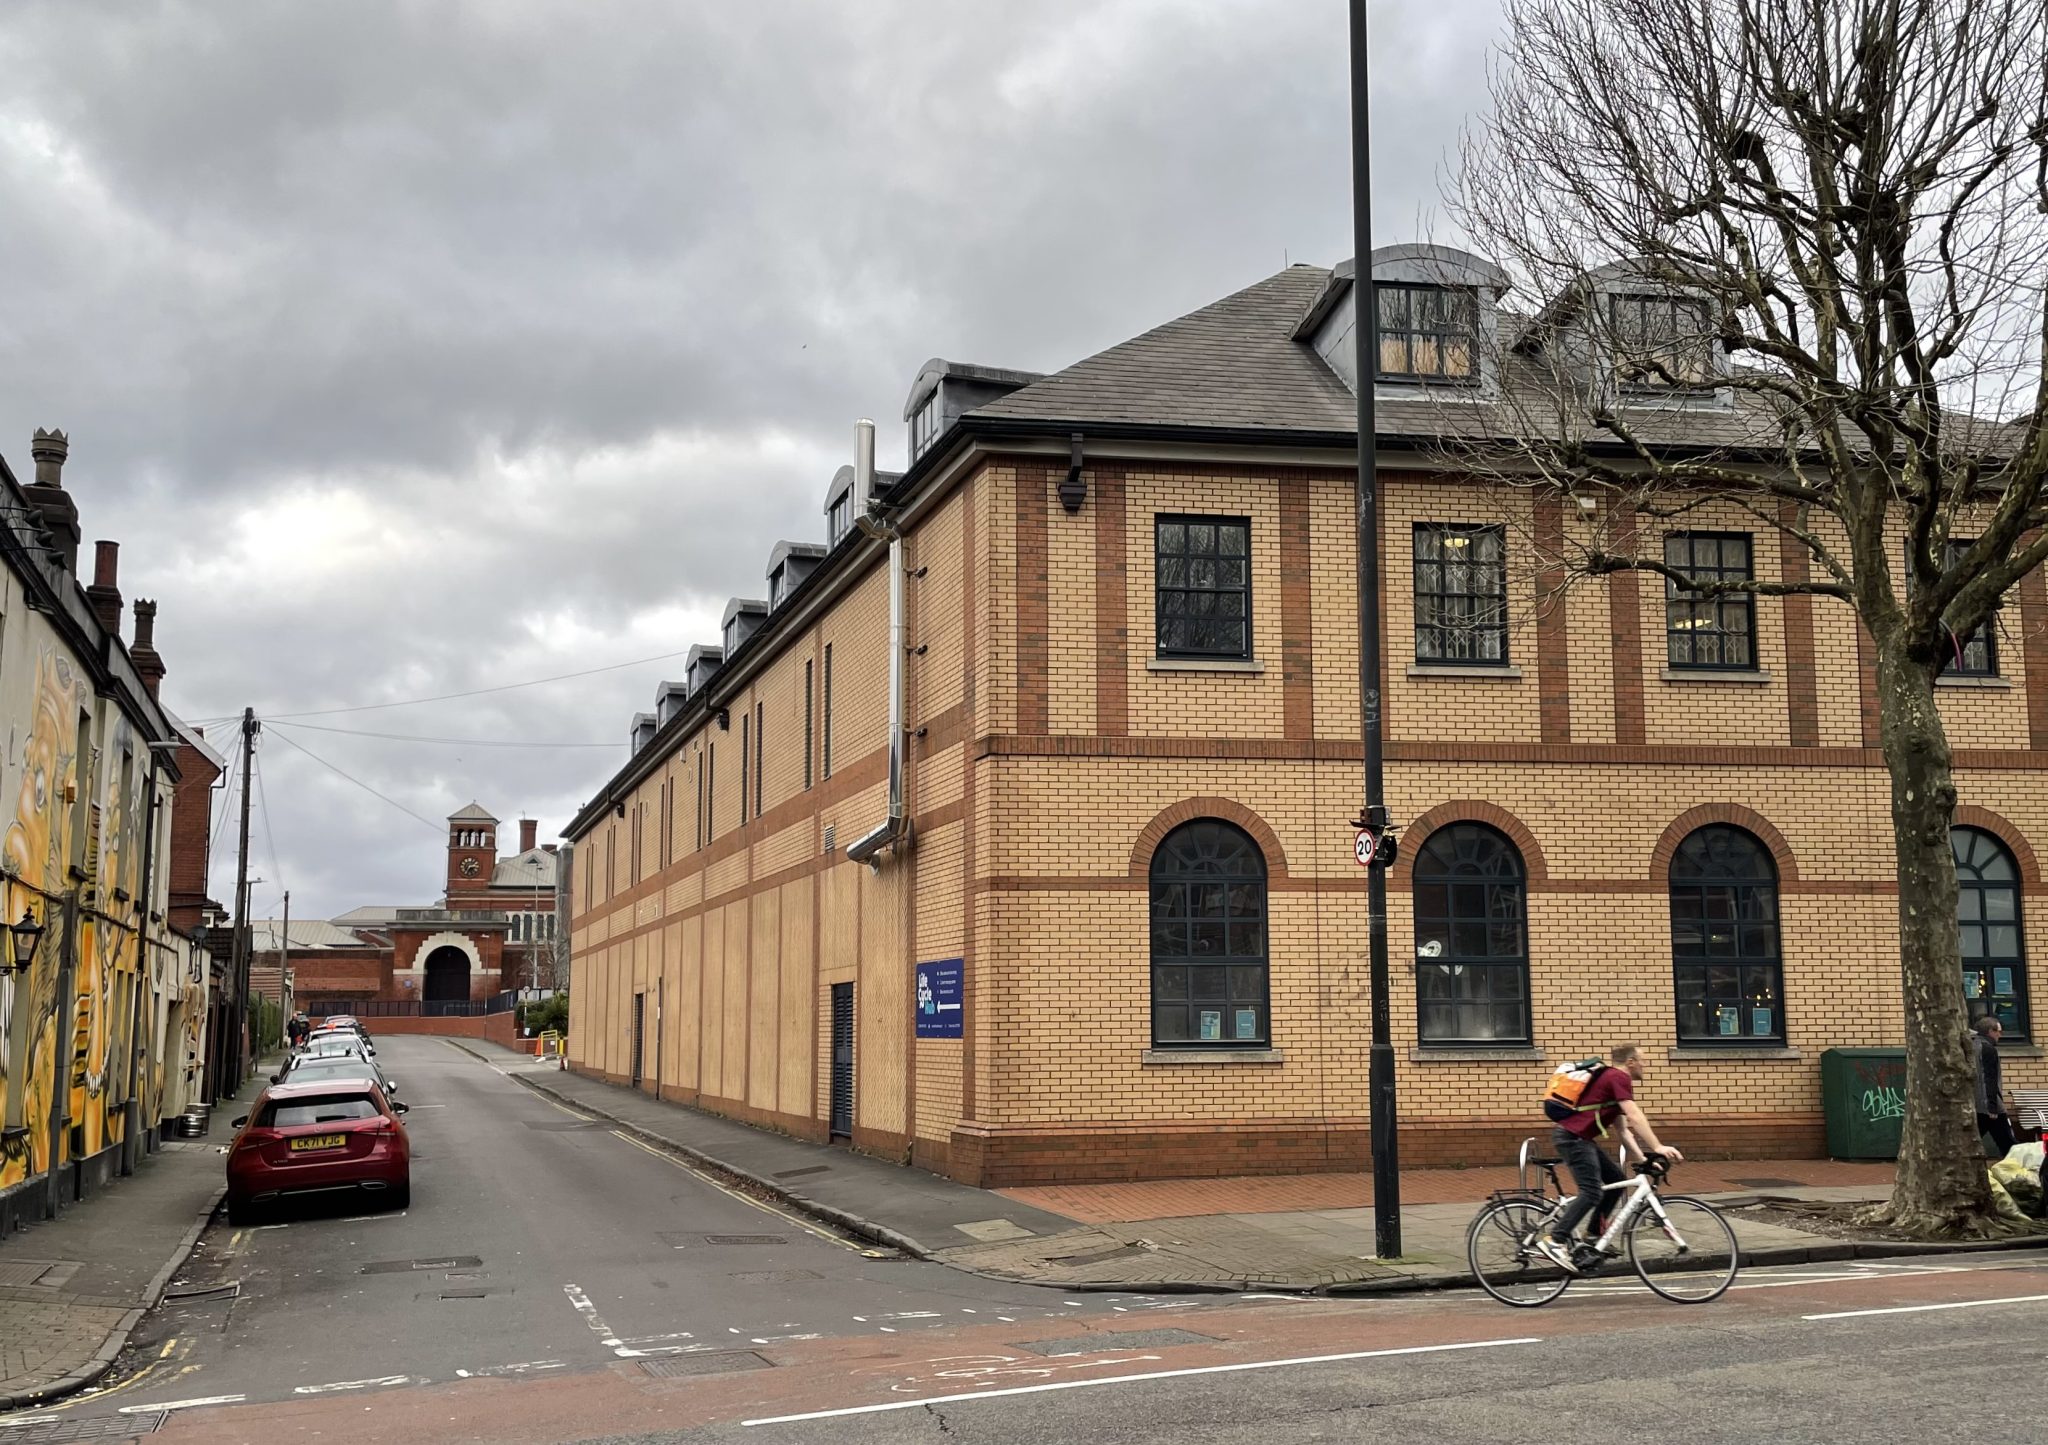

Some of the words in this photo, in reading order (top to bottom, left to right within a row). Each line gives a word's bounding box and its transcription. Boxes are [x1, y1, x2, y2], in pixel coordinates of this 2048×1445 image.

[1358, 840, 1371, 855] 20
[919, 972, 928, 987] Life
[918, 987, 932, 1008] Cycle
[925, 1000, 935, 1014] Hub
[297, 1137, 319, 1148] CK71
[321, 1136, 340, 1146] VJG
